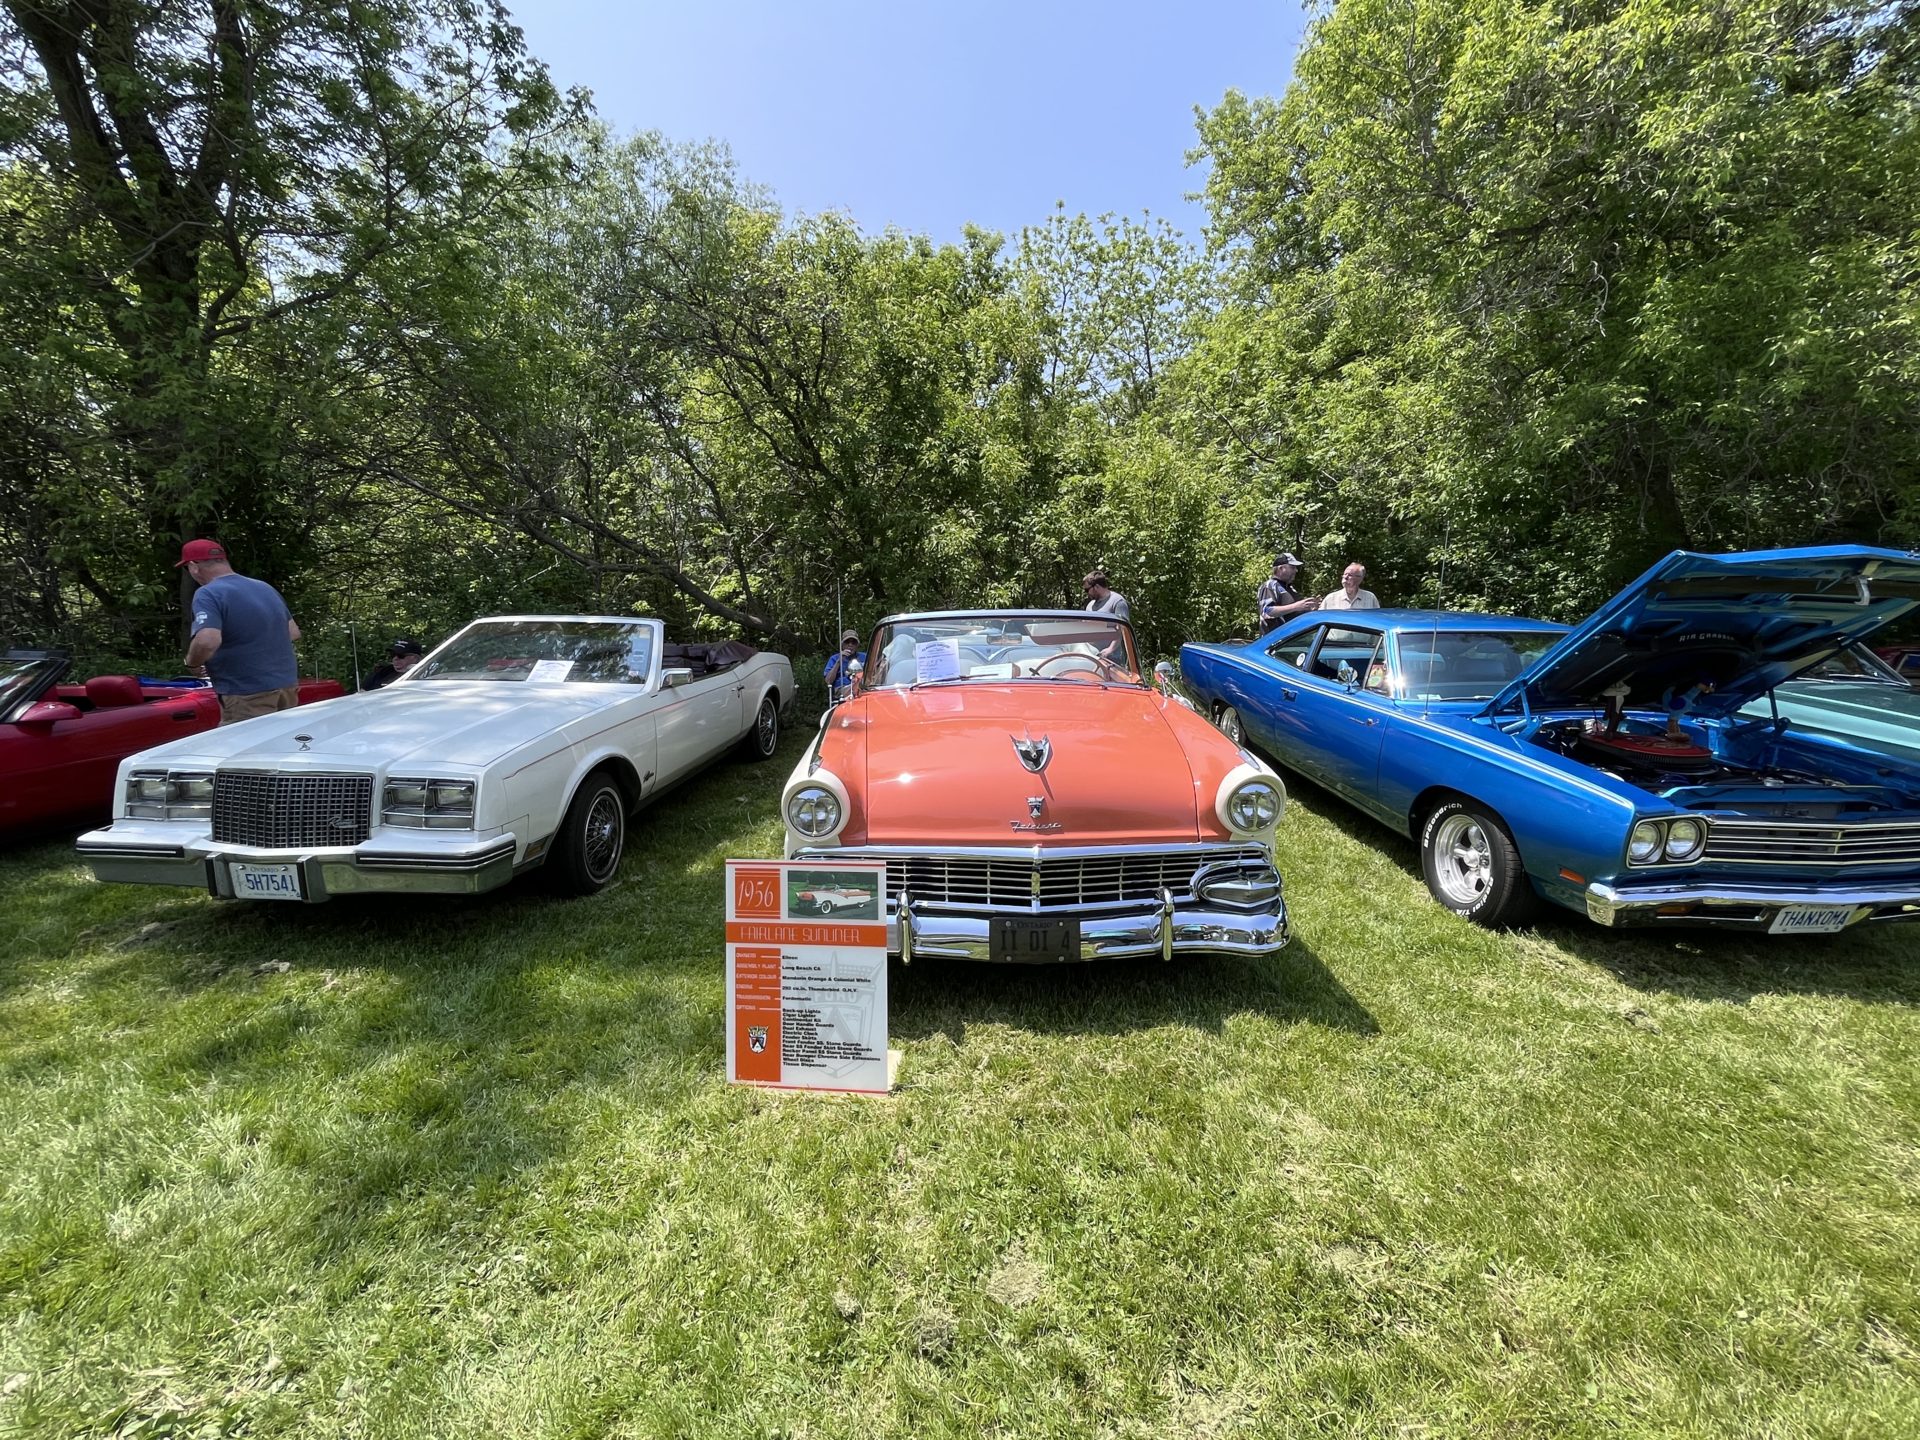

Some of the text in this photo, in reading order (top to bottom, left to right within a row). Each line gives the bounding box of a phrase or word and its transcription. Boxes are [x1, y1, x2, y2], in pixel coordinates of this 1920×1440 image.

[245, 873, 297, 892] 5H7541
[738, 880, 774, 908] 1956
[740, 925, 860, 943] FAIRLANE SUNLINER
